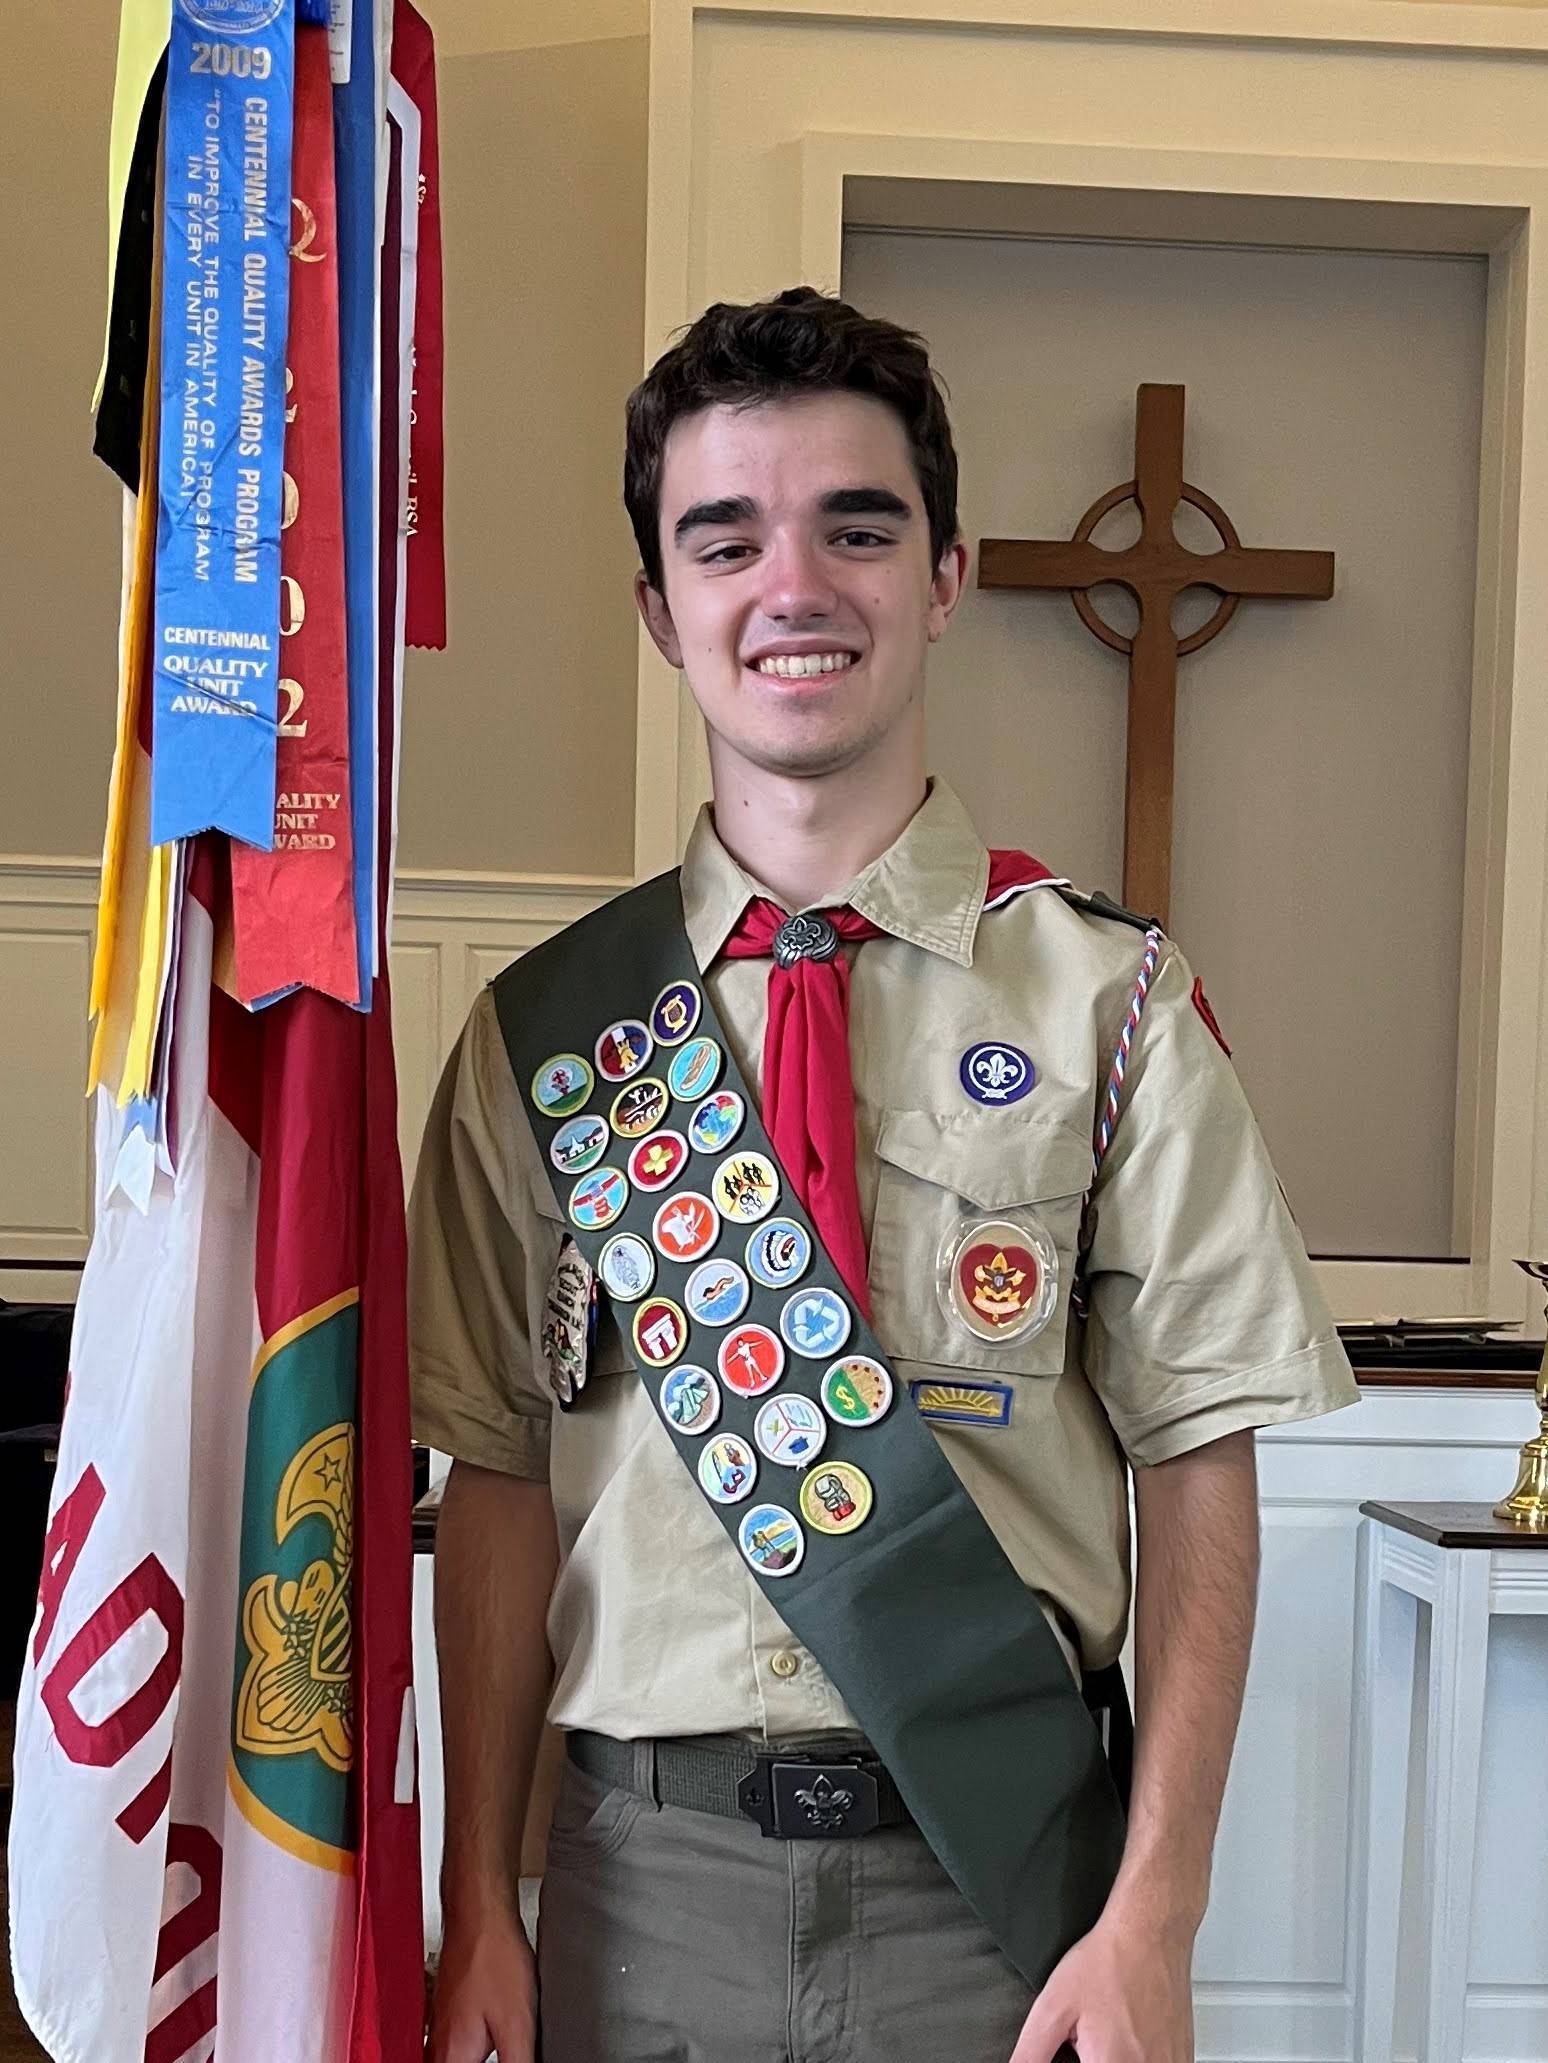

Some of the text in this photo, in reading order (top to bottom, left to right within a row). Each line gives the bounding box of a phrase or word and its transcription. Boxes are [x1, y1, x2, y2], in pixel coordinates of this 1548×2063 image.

[190, 42, 272, 80] 2009
[187, 155, 203, 180] IN
[203, 136, 220, 244] IMPROVE
[186, 191, 202, 267] EVERY
[204, 255, 219, 299] THE
[186, 281, 202, 336] UNIT
[185, 342, 200, 367] IN
[201, 307, 219, 407] QUALITY
[234, 97, 268, 583] CENTENNIAL QUALITY AWARDS PROGRAM
[200, 419, 216, 450] OF
[194, 460, 214, 581] PROGRAM
[163, 627, 271, 651] CENTENNIAL
[163, 655, 268, 678] QUALITY
[276, 793, 341, 809] ALITY
[273, 834, 336, 850] WARD
